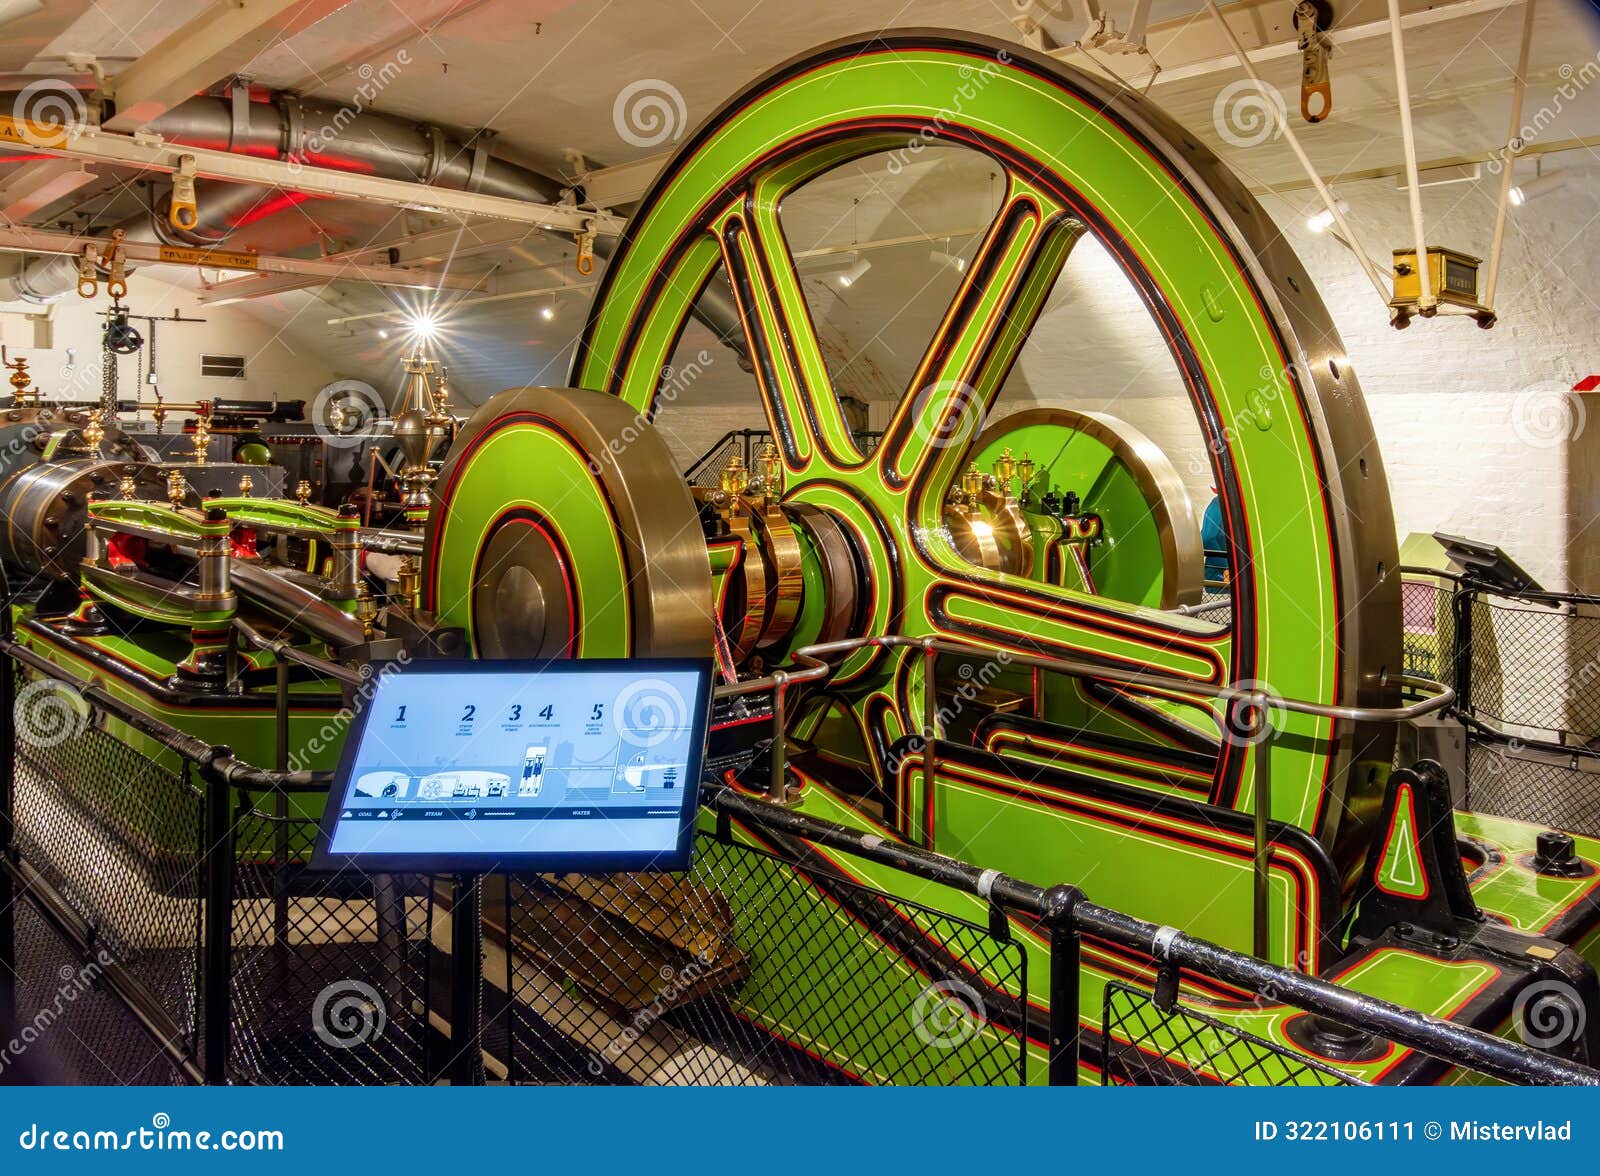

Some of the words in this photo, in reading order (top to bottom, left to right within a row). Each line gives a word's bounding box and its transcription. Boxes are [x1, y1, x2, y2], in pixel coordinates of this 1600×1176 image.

[395, 705, 407, 721] 1
[461, 704, 476, 721] 2
[508, 704, 522, 721] 3
[538, 704, 553, 721] 4
[590, 703, 604, 720] 5
